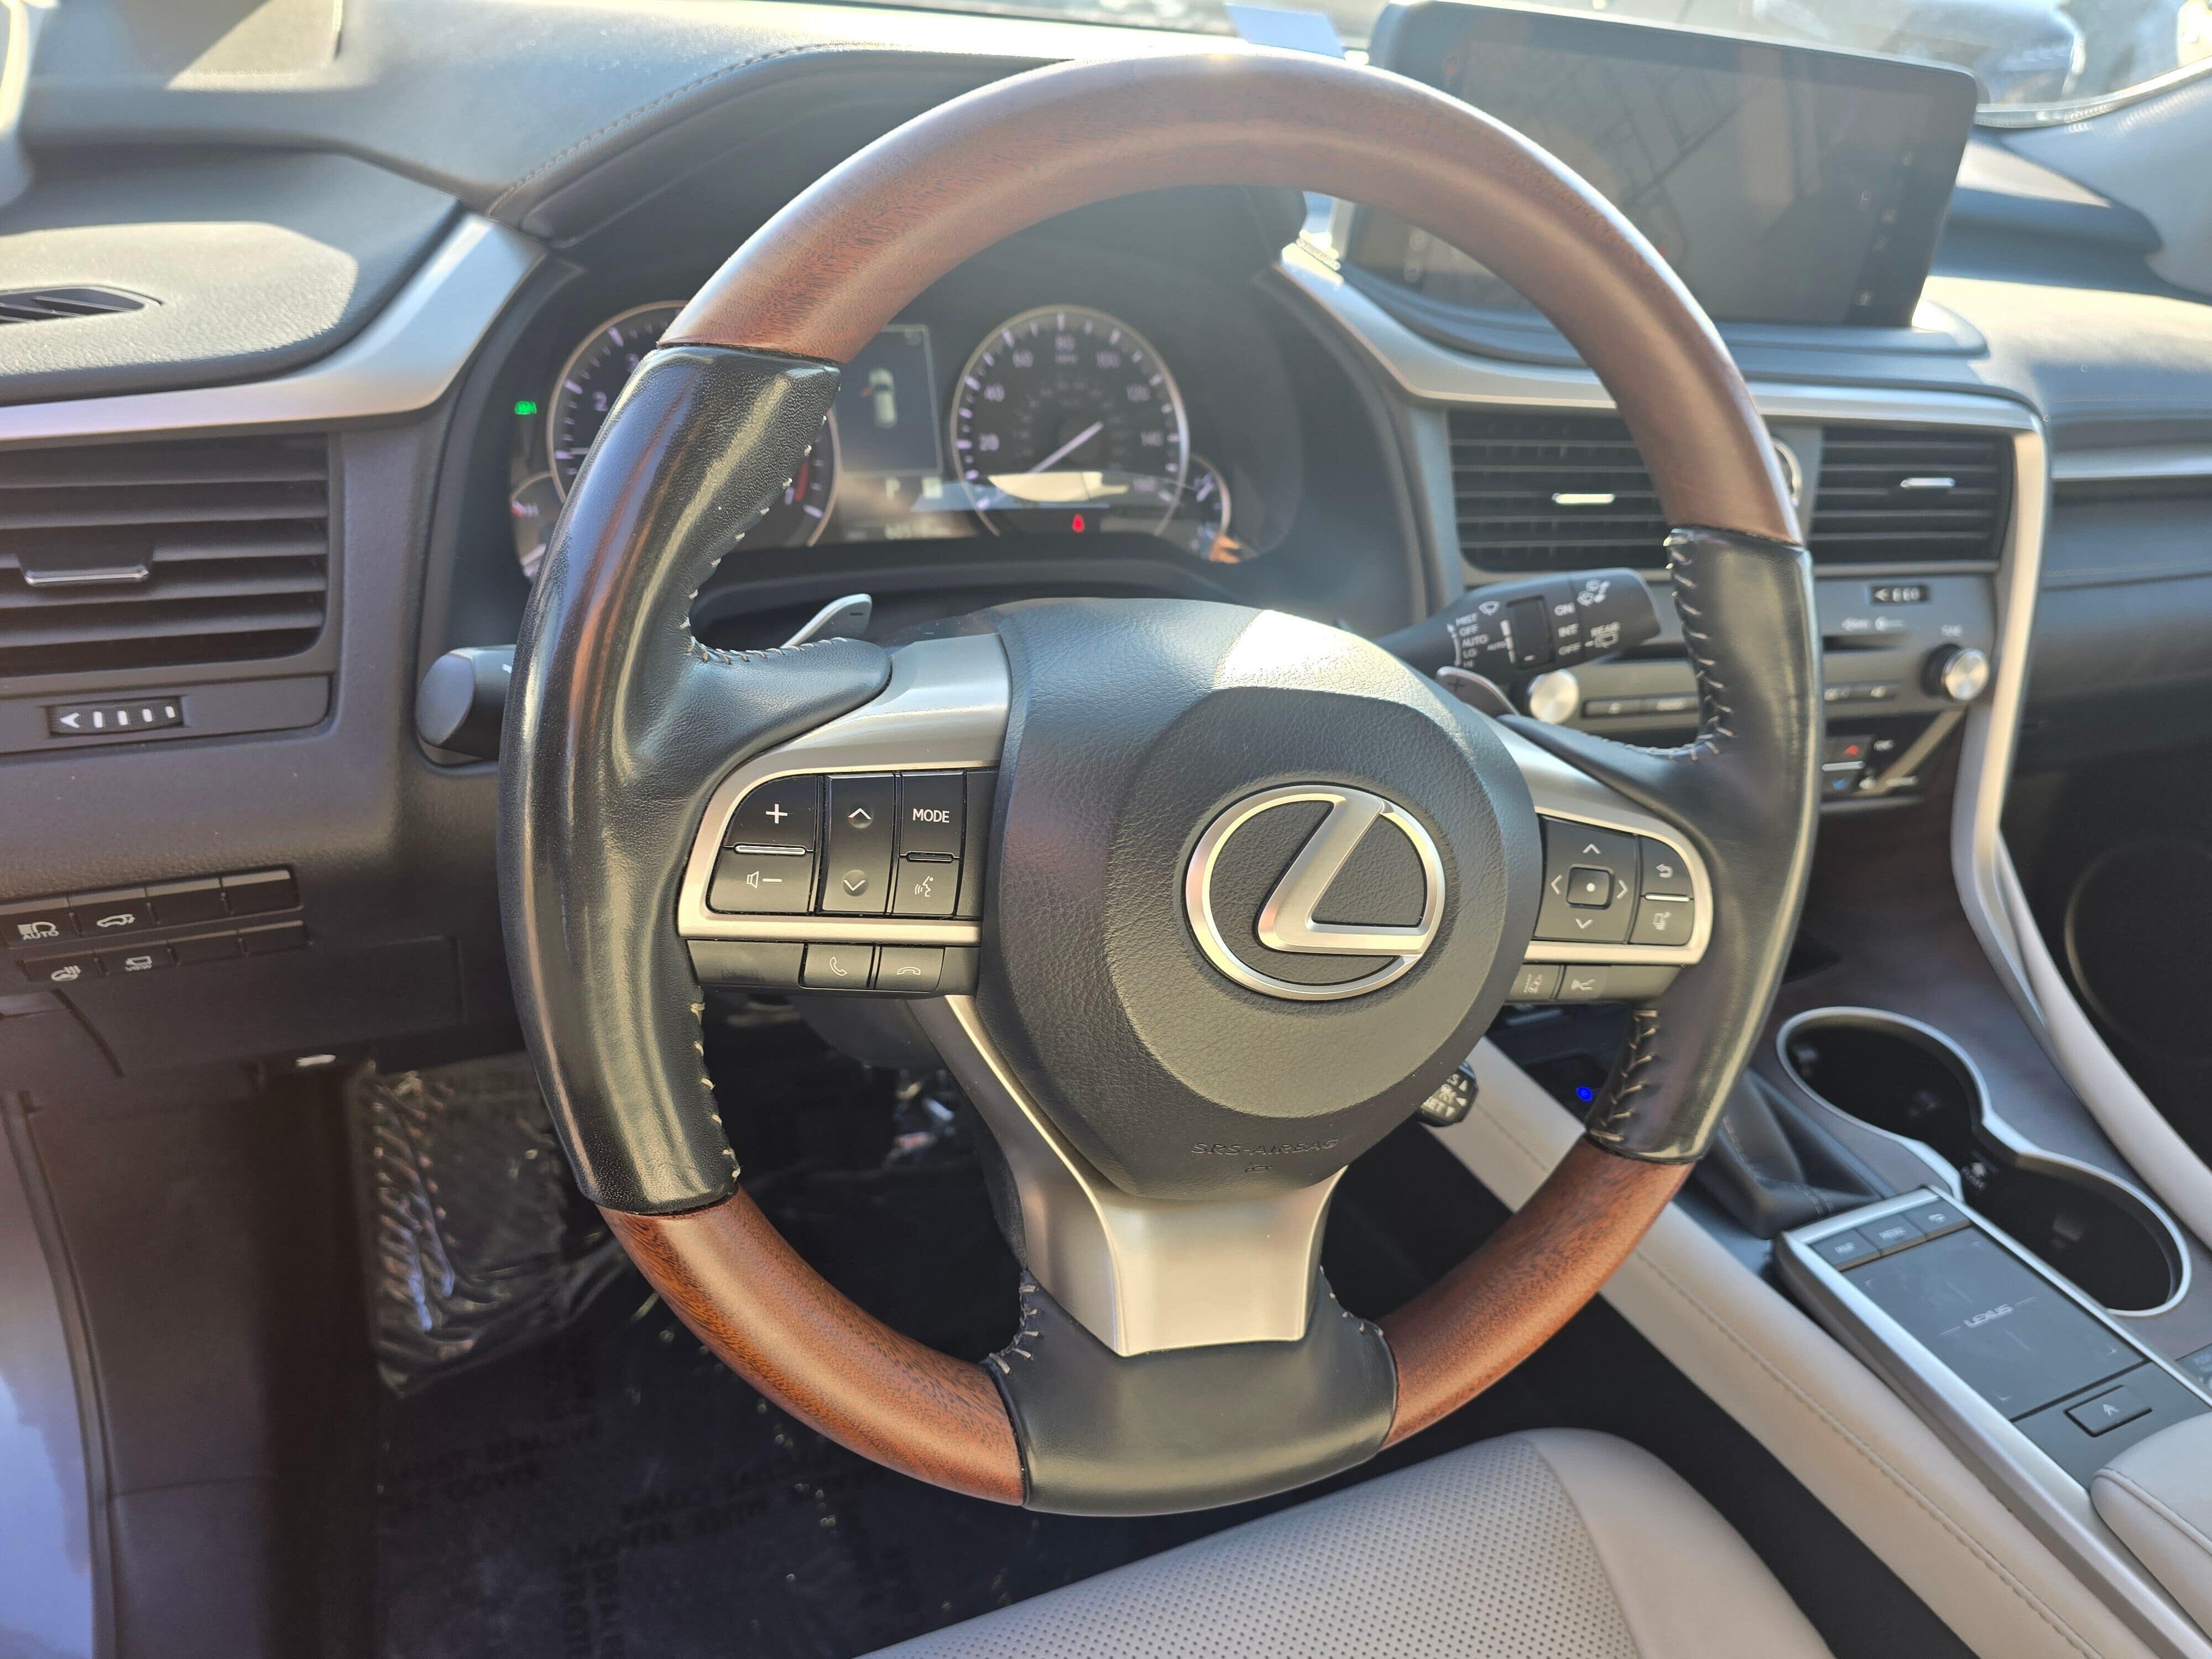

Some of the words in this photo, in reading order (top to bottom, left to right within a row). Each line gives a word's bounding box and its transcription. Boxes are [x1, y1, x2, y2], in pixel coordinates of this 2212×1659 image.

[1554, 603, 1575, 616] ON
[1459, 624, 1479, 637] OFF
[1558, 623, 1579, 637] INT
[1590, 622, 1620, 637] REAR
[1462, 634, 1489, 648] AUTO
[1559, 641, 1582, 655] OFF
[912, 808, 950, 823] MODE
[22, 930, 60, 941] AUTO
[1191, 1138, 1339, 1156] SRS-AIRBAG
[1963, 1304, 2013, 1328] LEXUS
